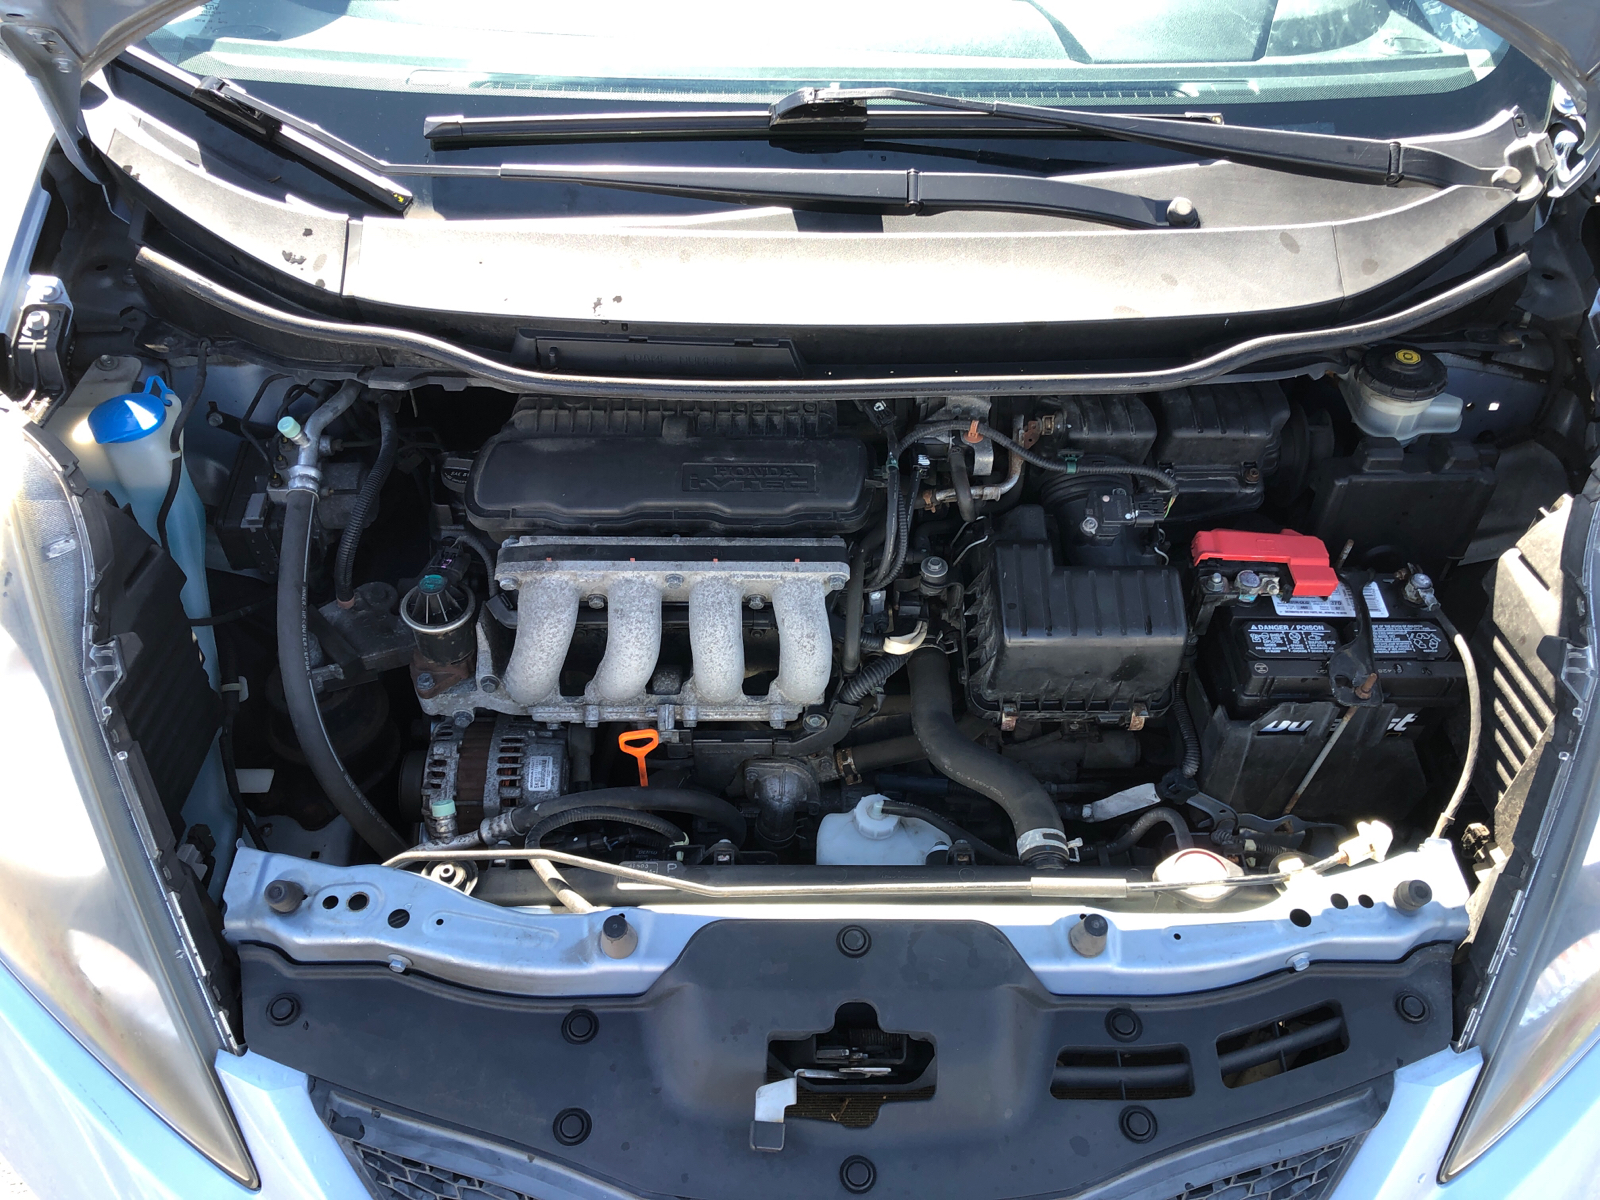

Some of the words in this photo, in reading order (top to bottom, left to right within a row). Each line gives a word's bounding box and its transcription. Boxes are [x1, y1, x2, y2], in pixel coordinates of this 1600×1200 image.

[622, 354, 665, 365] FRAME
[713, 466, 799, 478] HONDA
[689, 474, 808, 491] i-VTEC
